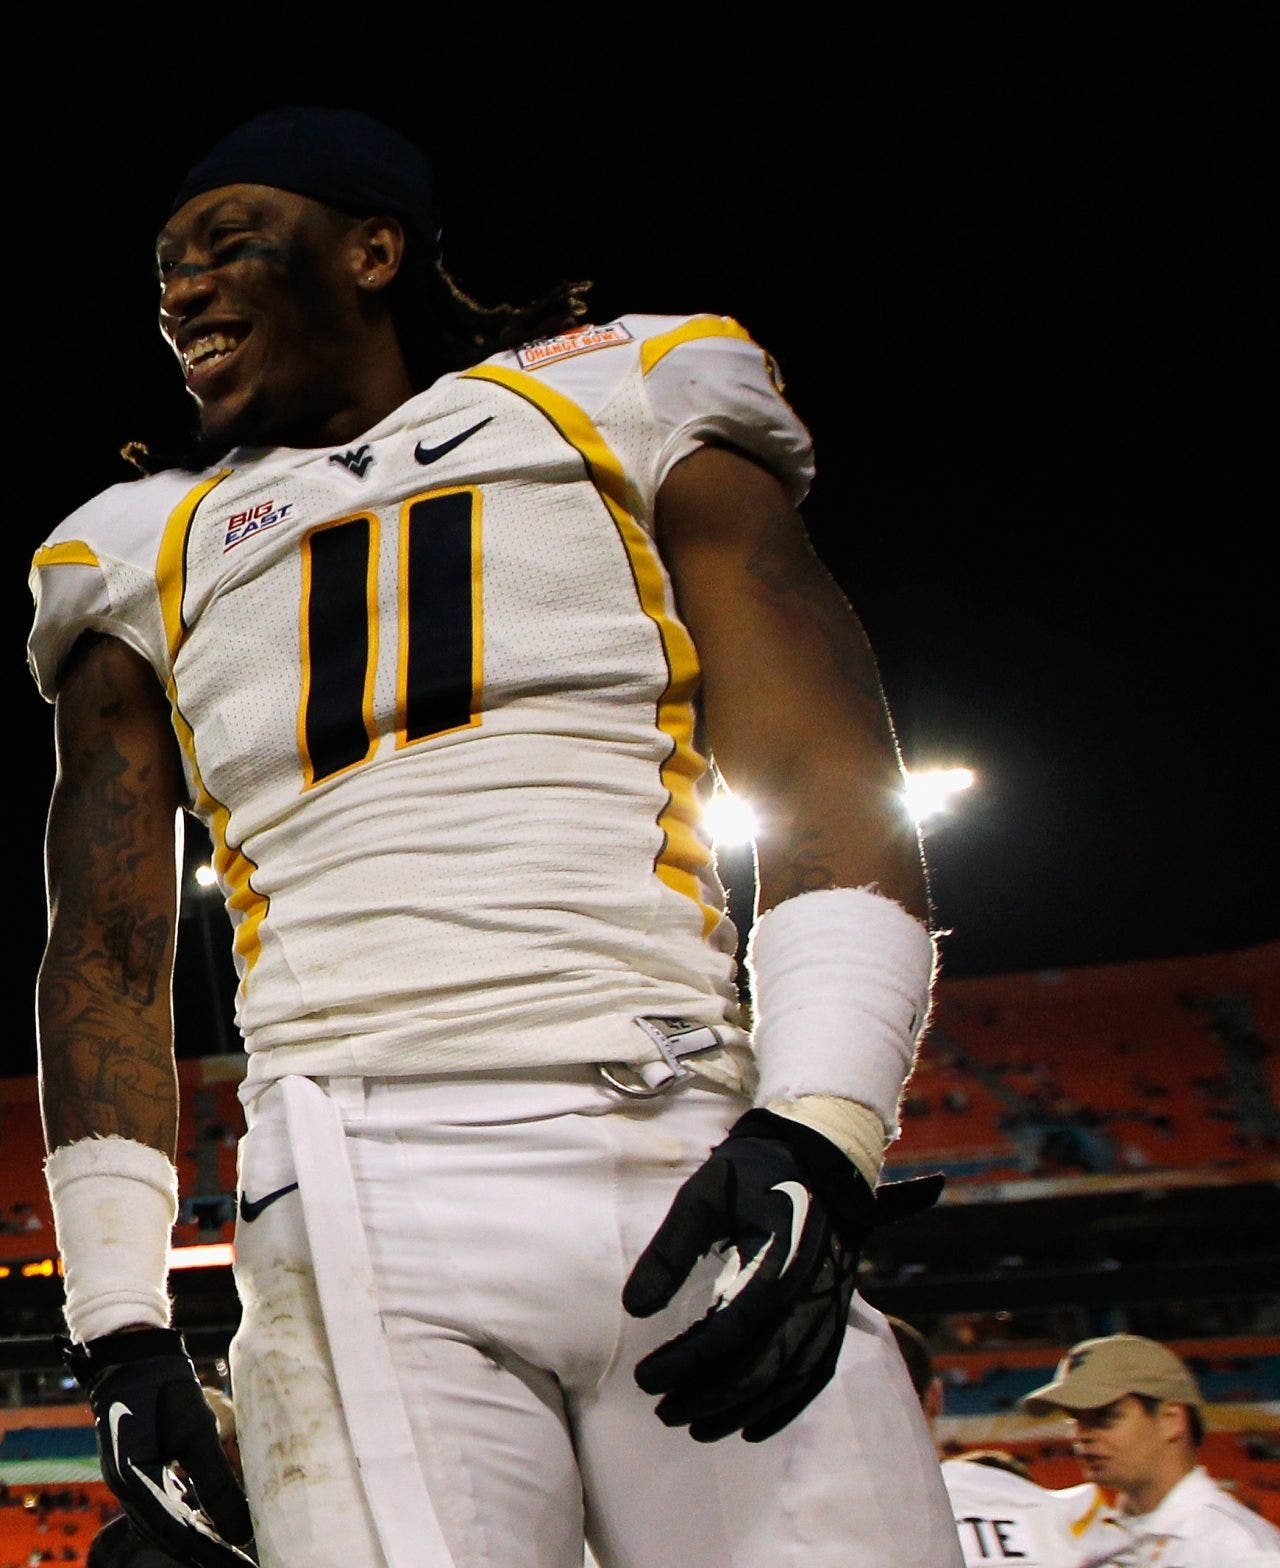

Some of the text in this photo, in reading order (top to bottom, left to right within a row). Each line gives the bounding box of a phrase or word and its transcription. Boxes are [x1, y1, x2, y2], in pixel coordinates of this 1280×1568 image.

[224, 503, 295, 546] EAST
[228, 500, 275, 531] BIG
[297, 484, 485, 794] 11
[957, 1516, 1026, 1559] TE
